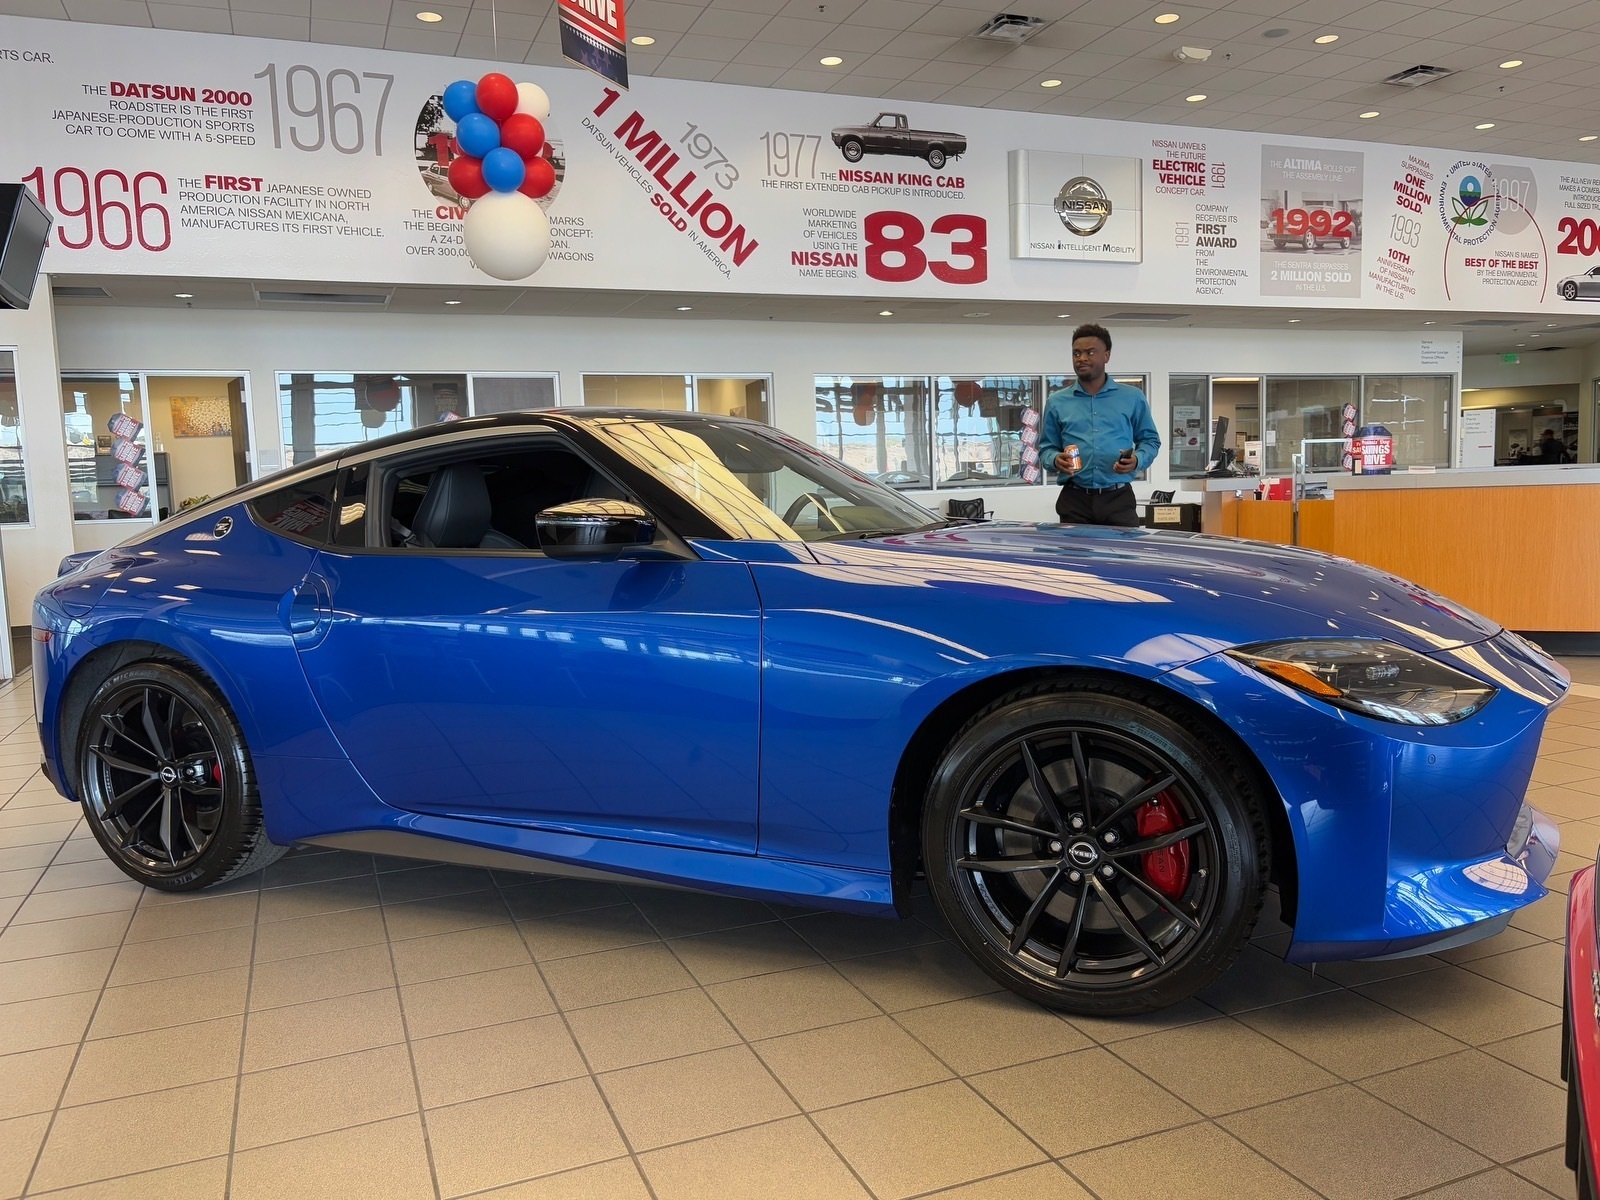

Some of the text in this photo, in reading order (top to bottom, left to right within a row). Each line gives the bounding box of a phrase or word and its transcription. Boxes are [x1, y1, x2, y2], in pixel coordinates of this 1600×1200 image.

[23, 51, 54, 63] CAR.
[82, 82, 252, 106] THE DATSUN 2000
[109, 100, 253, 119] ROADSTER THE FIRST
[254, 62, 394, 157] 1967
[52, 110, 254, 133] JAPANESE-PRODUCTION SPORTS
[66, 124, 255, 146] CAR TO COME WITH A 5-SPEED
[1152, 140, 1206, 150] NISSAN UNVEILS
[679, 121, 740, 191] 1973
[760, 132, 821, 179] 1977
[1166, 150, 1206, 160] THE FUTURE
[1408, 155, 1430, 170] MAXIMA
[1153, 159, 1205, 173] ELECTRIC
[1270, 160, 1282, 168] THE
[1284, 158, 1322, 171] ALTIMA
[1401, 161, 1434, 180] SURPASSES
[581, 116, 687, 232] DATSUN VEHICLES SOLD
[593, 86, 759, 268] 1 MILLION
[820, 169, 965, 189] THE NISSAN KING CAB
[1159, 173, 1206, 186] VEHICLE
[1211, 161, 1225, 189] 1991
[1296, 172, 1328, 182] ASSEMBLY
[1329, 174, 1342, 182] LINE
[1405, 174, 1426, 189] ONE
[1571, 177, 1592, 185] ALL-NEW
[178, 175, 371, 199] THE FIRST JAPANESE OWNED
[761, 179, 965, 199] THE FIRST EXTENDED CAB PICKUP INTRODUCED.
[1156, 186, 1205, 196] CONCEPT CAR.
[1393, 181, 1432, 205] MILLION
[179, 192, 370, 211] PRODUCTION FACILITY IN NORTH
[1491, 179, 1530, 212] 1997
[22, 166, 171, 252] 1966
[1062, 200, 1108, 211] NISSAN
[1196, 204, 1228, 212] COMPANY
[1396, 196, 1423, 214] SOLD.
[180, 205, 348, 224] AMERICA NISSAN MEXICANA,
[412, 209, 584, 226] THE MARKS
[803, 208, 857, 218] WORLDWIDE
[1196, 214, 1237, 223] RECEIVES ITS
[181, 219, 385, 237] MANUFACTURES ITS FIRST VEHICLE.
[403, 221, 424, 230] THE
[808, 219, 857, 229] MARKETING
[1196, 224, 1226, 235] FIRST
[1272, 208, 1352, 238] 1992
[1390, 213, 1421, 248] 1993
[431, 235, 437, 243] A
[803, 230, 857, 240] OF VEHICLES
[1175, 222, 1189, 248] 1991
[1196, 237, 1237, 248] AWARD
[1557, 217, 1600, 256] 20
[406, 246, 594, 261] OVER WAGONS
[813, 241, 857, 251] USING THE
[864, 211, 988, 284] 83
[1103, 244, 1135, 253] MOBILITY
[1196, 249, 1214, 257] FROM
[792, 251, 858, 267] NISSAN
[1387, 249, 1410, 264] 10TH
[1465, 258, 1538, 270] BEST OF THE BEST
[799, 268, 858, 278] NAME BEGINS.
[1196, 268, 1248, 277] ENVIRONMENTAL
[1274, 261, 1348, 271] THE SENTRA SURPASSES
[1377, 257, 1416, 276] ANNIVERSARY
[1196, 278, 1236, 286] PROTECTION
[1271, 270, 1351, 283] 2 MILLION SOLD
[1368, 272, 1416, 295] MANUFACTURING
[1387, 269, 1409, 283] NISSAN
[1362, 445, 1390, 454] SAVINGS
[1364, 455, 1386, 464] DRIVE
